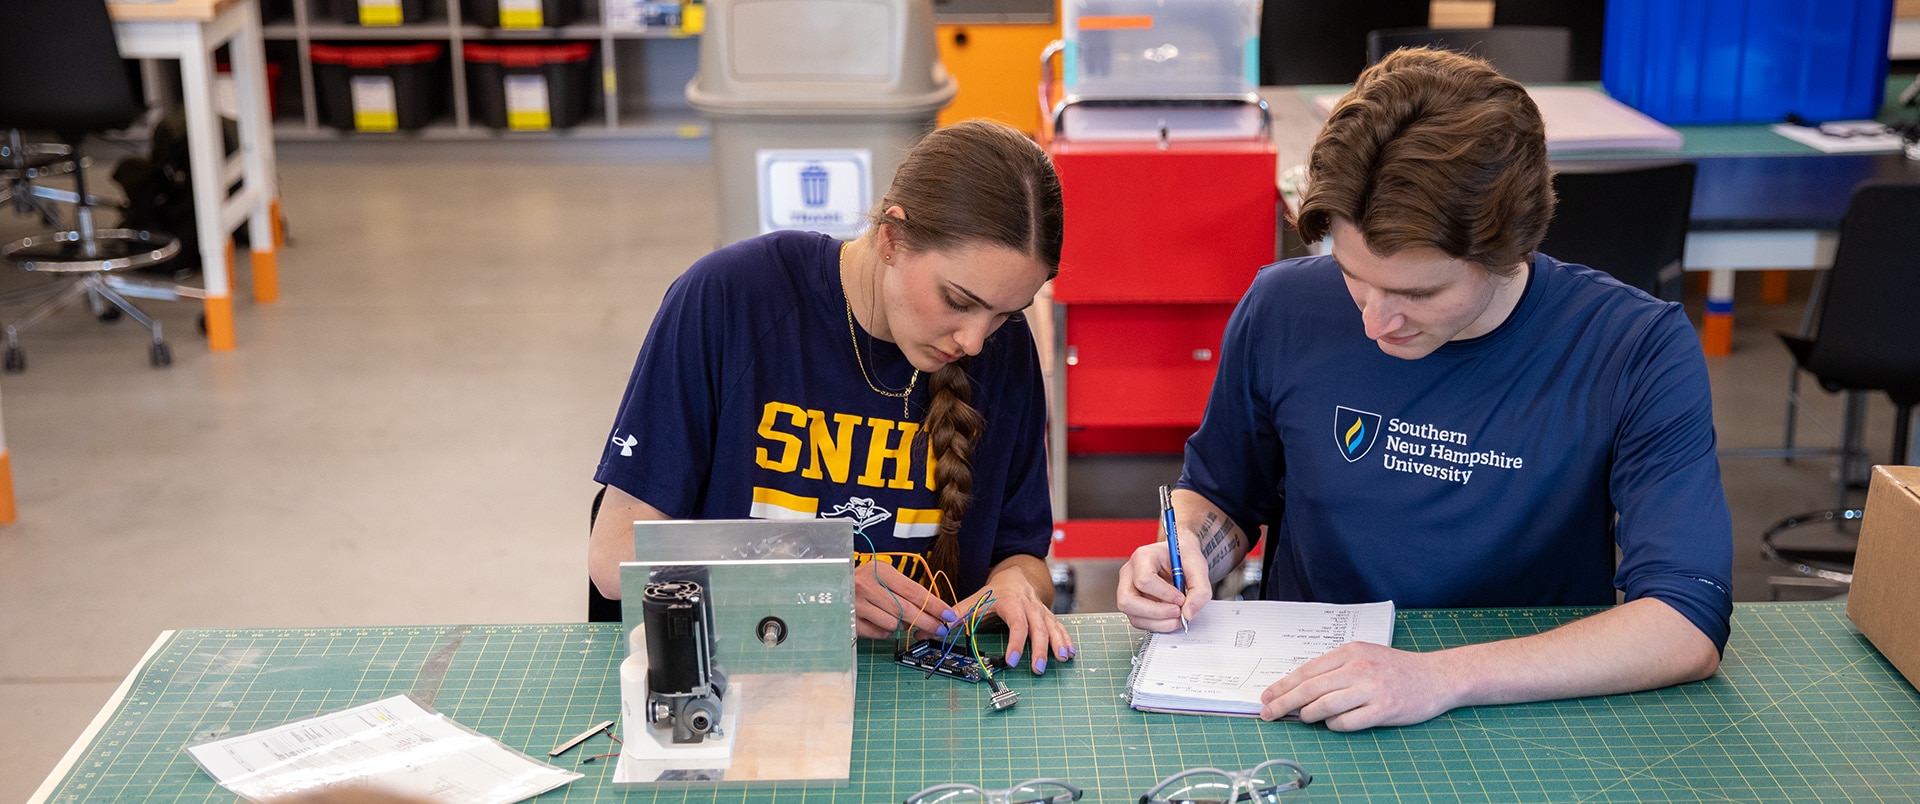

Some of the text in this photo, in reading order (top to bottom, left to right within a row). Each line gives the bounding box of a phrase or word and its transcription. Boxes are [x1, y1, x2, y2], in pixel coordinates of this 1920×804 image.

[1388, 418, 1468, 446] Southern
[1385, 435, 1524, 470] New Hampshire
[1383, 454, 1473, 486] University
